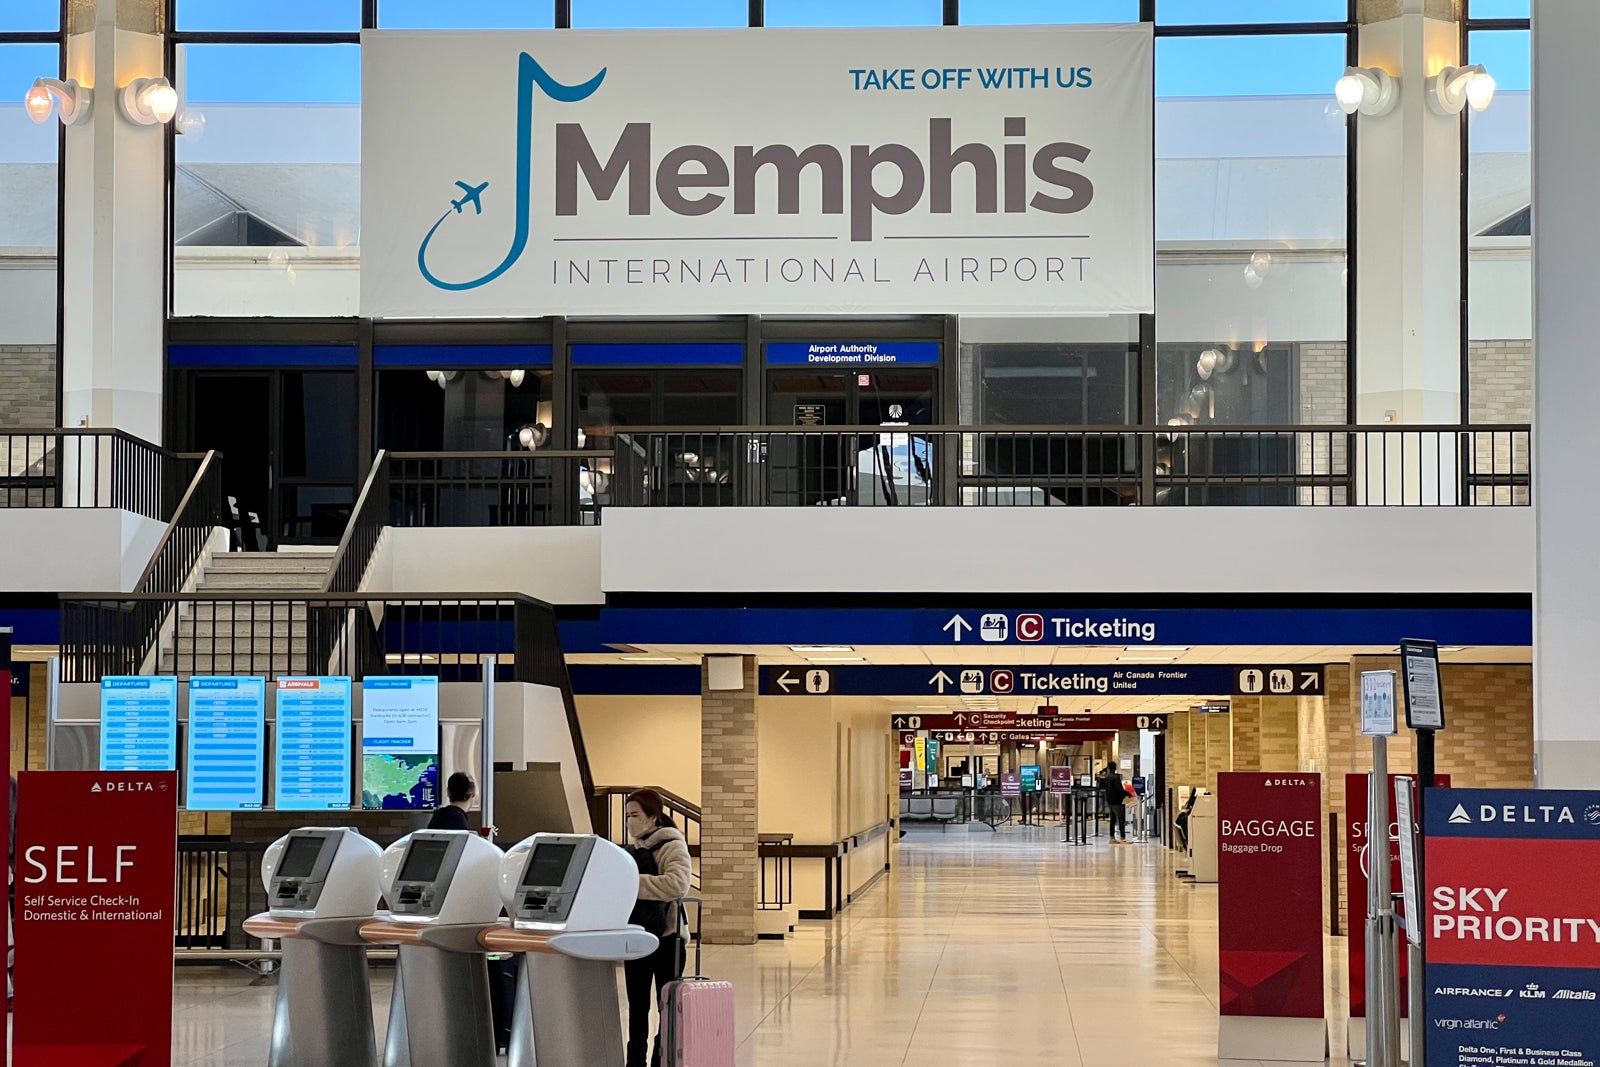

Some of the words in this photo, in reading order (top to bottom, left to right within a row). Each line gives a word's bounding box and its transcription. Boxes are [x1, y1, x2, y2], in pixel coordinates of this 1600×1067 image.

[849, 69, 915, 90] TAKE
[921, 68, 972, 89] OFF
[977, 67, 1049, 89] WITH
[1056, 67, 1093, 88] US
[556, 117, 1093, 242] Memphis
[553, 258, 891, 284] INTERNATIONAL
[913, 257, 1091, 282] AIRPORT
[809, 344, 837, 354] Airport
[840, 344, 877, 354] Authority
[808, 354, 861, 363] Development
[864, 354, 896, 362] Division
[1020, 617, 1039, 638] C
[1051, 618, 1155, 641] Ticketing
[1113, 671, 1123, 679] Air
[1126, 671, 1155, 679] Canada
[1158, 671, 1187, 679] Frontier
[994, 673, 1009, 690] C
[1020, 673, 1108, 692] Ticketing
[1113, 681, 1137, 689] United
[970, 714, 980, 724] C
[1016, 717, 1051, 729] cketing
[106, 782, 153, 792] DELTA
[1480, 804, 1575, 824] DELTA
[1221, 820, 1315, 837] BAGGAGE
[1222, 843, 1259, 854] Baggage
[1261, 843, 1283, 854] Drop
[24, 845, 137, 884] SELF
[24, 895, 45, 906] Self
[47, 895, 87, 906] Service
[90, 895, 139, 906] Check-In
[1432, 886, 1508, 912] SKY
[24, 910, 77, 921] Domestic
[80, 910, 89, 921] &
[92, 909, 162, 921] International
[1433, 914, 1600, 943] PRIORITY
[1434, 987, 1502, 997] AIRFRANCE
[1519, 990, 1546, 999] KLM
[1552, 989, 1597, 1000] Alitalia
[1434, 1018, 1462, 1029] virgin
[1464, 1018, 1499, 1029] atlantic
[1458, 1045, 1478, 1053] Delta
[1480, 1046, 1498, 1055] One,
[1500, 1047, 1516, 1055] First
[1525, 1048, 1559, 1056] Business
[1561, 1049, 1582, 1057] Class
[1458, 1055, 1494, 1064] Diamond,
[1496, 1056, 1528, 1065] Platinum
[1530, 1057, 1536, 1065] &
[1537, 1058, 1555, 1066] Gold
[1557, 1059, 1593, 1067] Medallion
